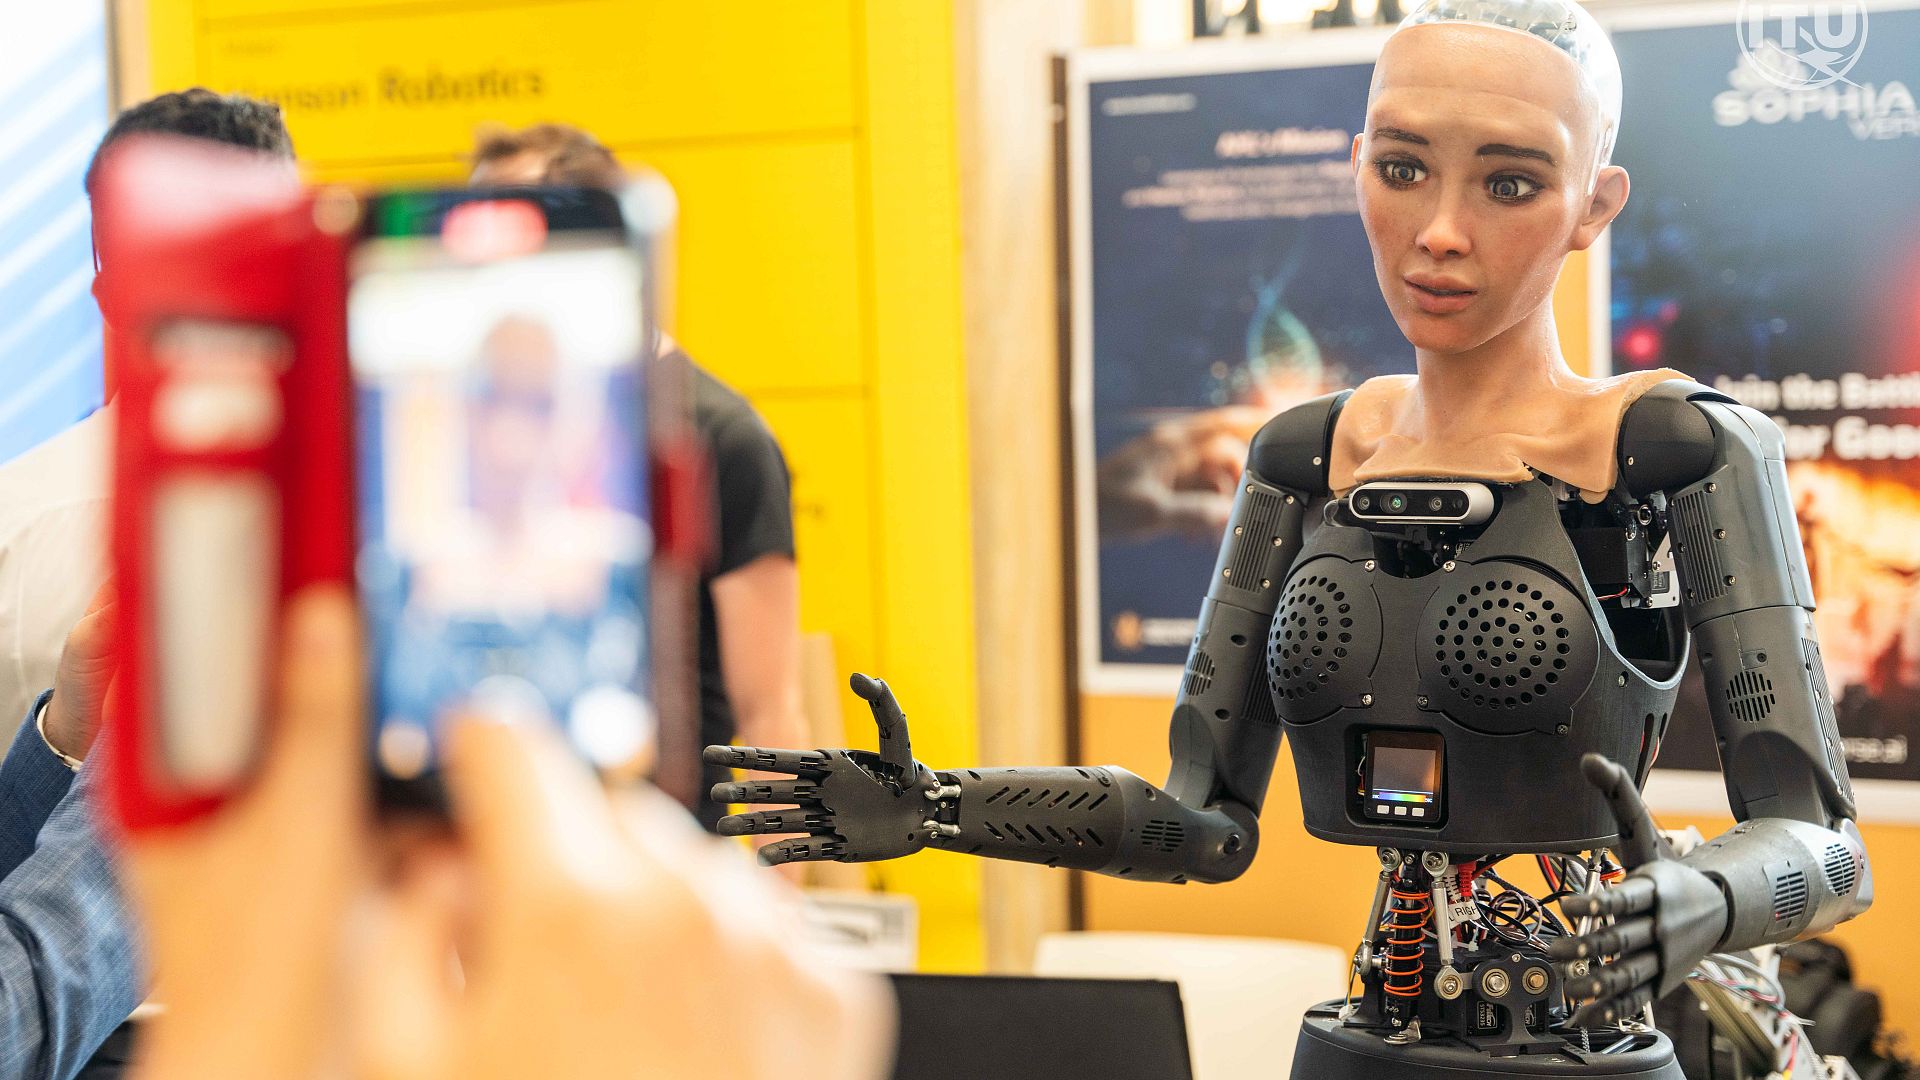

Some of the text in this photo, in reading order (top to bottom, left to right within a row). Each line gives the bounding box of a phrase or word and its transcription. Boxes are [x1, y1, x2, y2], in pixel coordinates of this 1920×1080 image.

[379, 63, 545, 105] Robotics
[1713, 81, 1916, 127] SOPHIA
[1781, 373, 1839, 411] the
